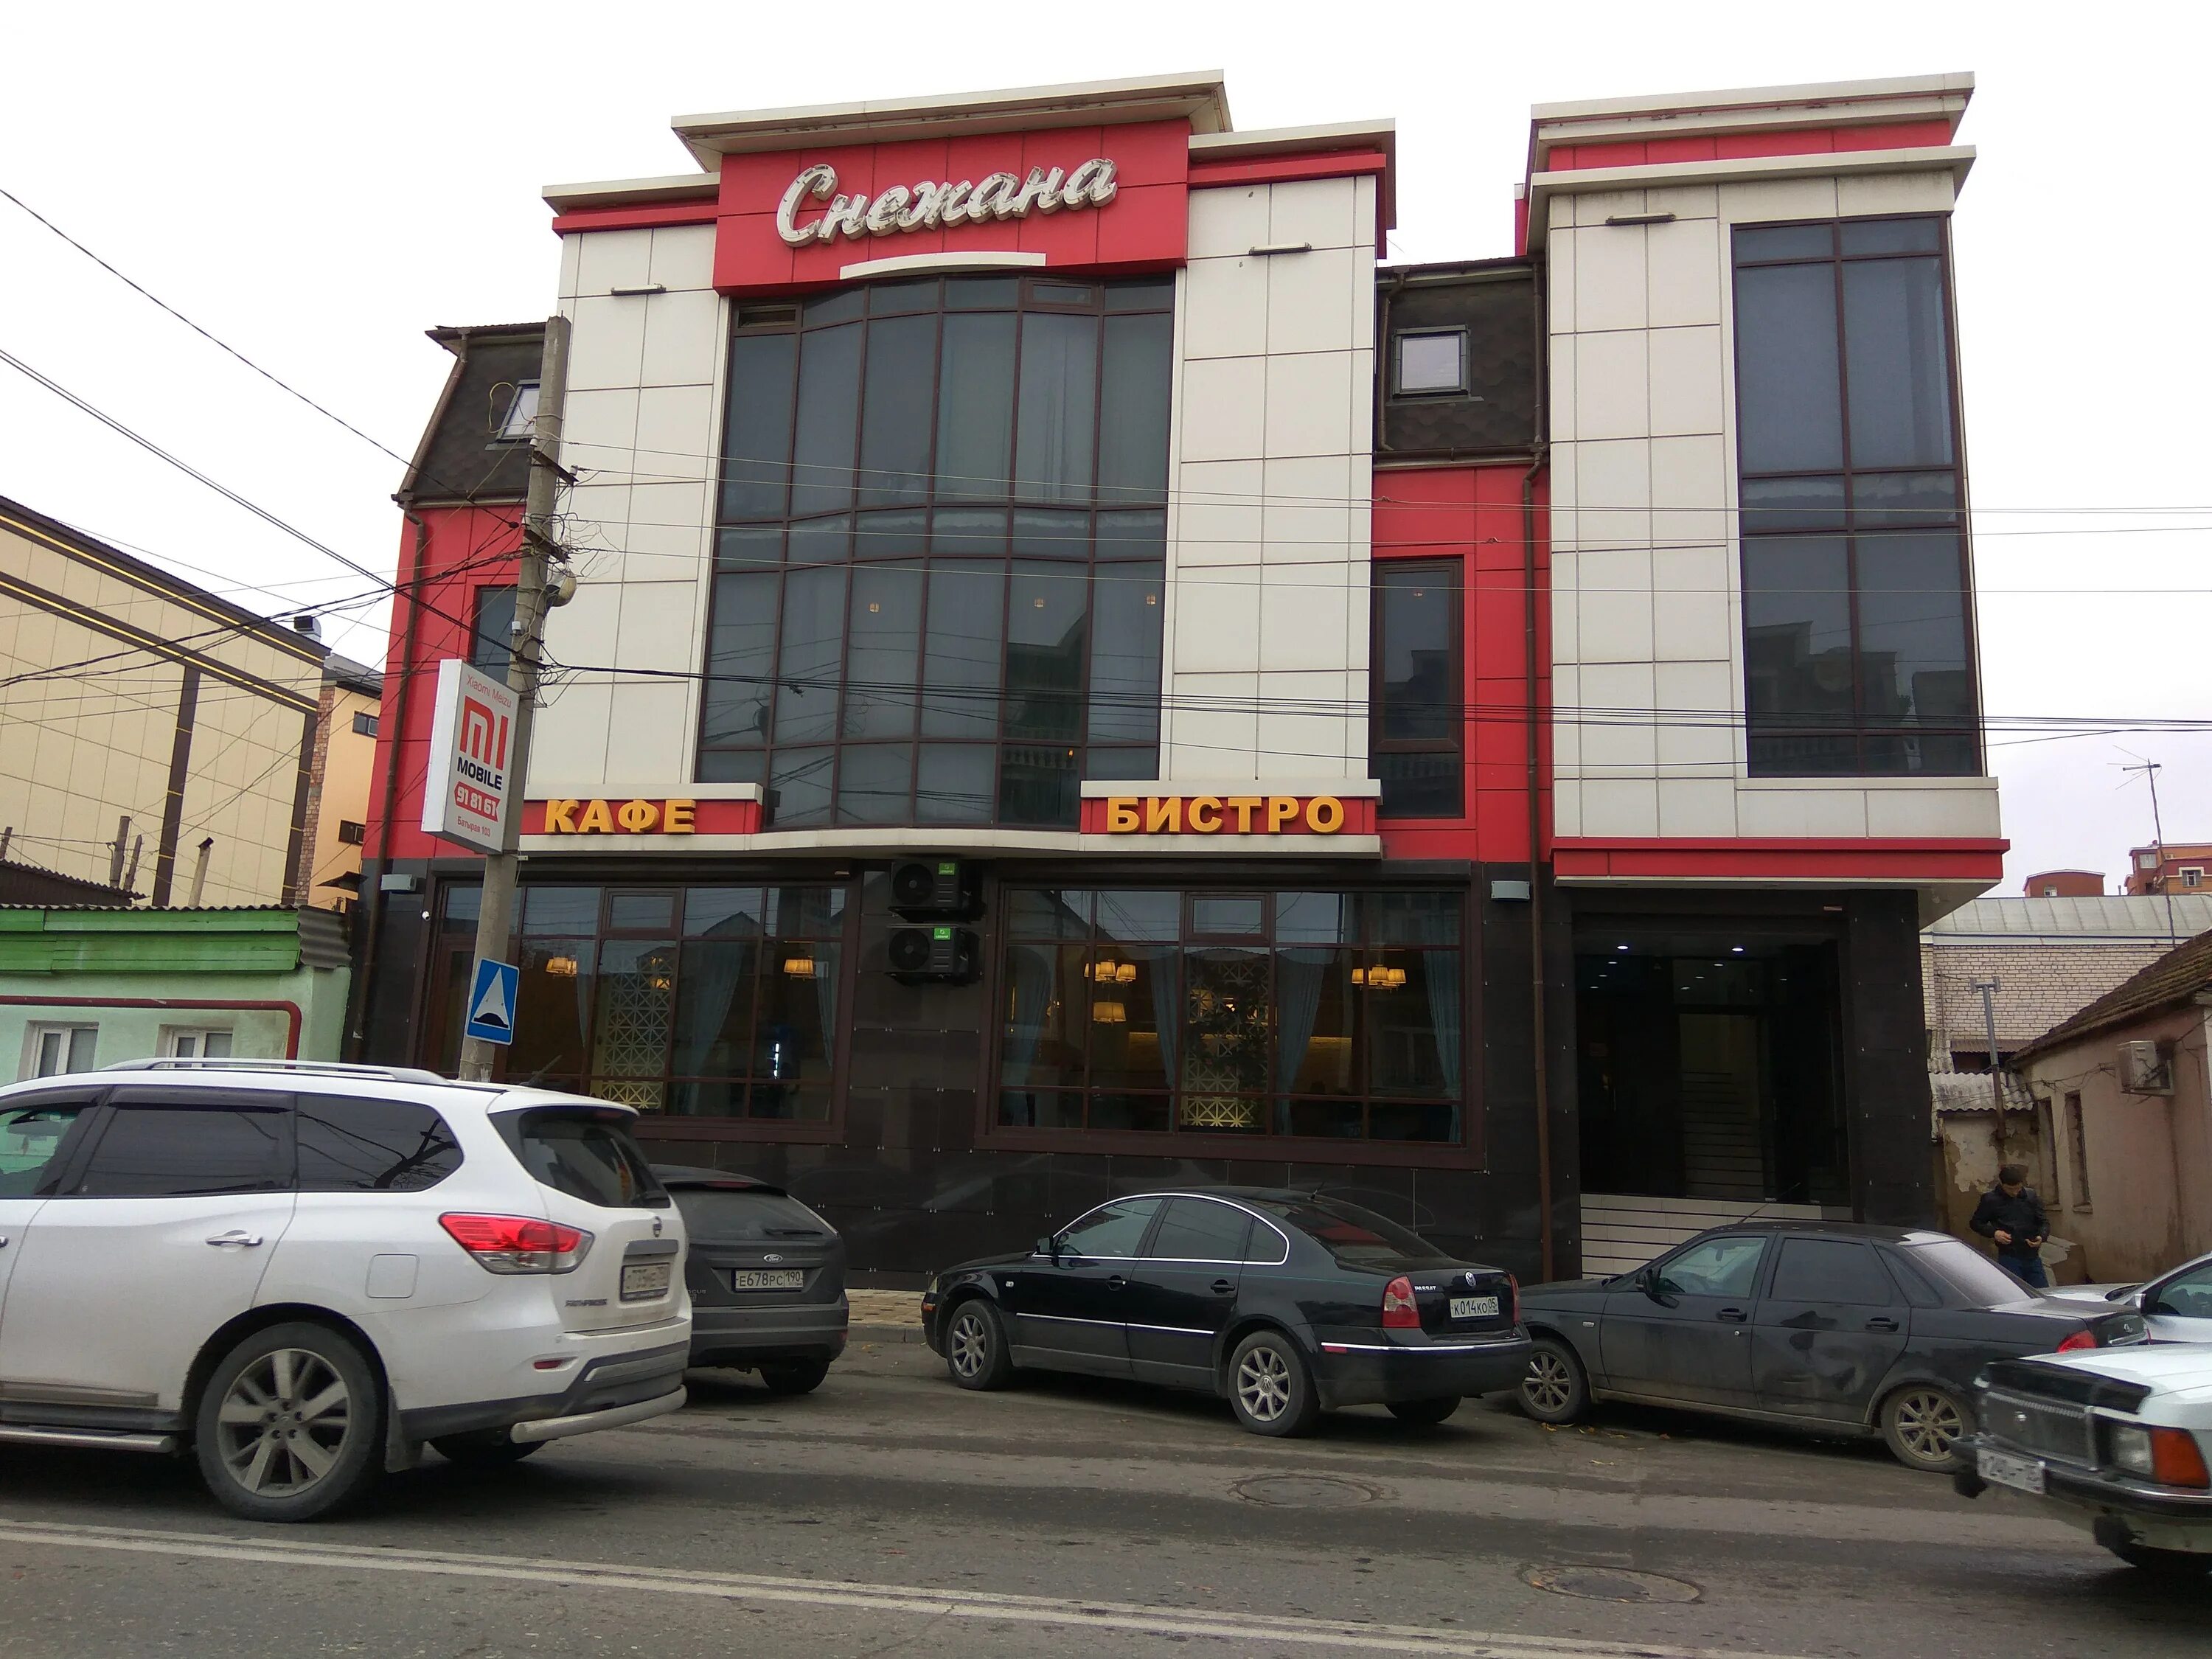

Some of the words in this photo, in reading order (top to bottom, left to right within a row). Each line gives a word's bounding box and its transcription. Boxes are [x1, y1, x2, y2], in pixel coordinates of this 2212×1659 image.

[776, 158, 1119, 248] Снежана
[467, 675, 490, 697] Xiaomi
[492, 689, 512, 708] Meizu
[457, 757, 502, 790] MOBILE
[457, 786, 469, 805] 91
[470, 792, 482, 811] 81
[484, 798, 496, 817] 61
[544, 799, 696, 834] КАФЕ
[1107, 796, 1344, 834] БИСТРО
[457, 815, 481, 833] Батырая
[481, 826, 491, 838] 103
